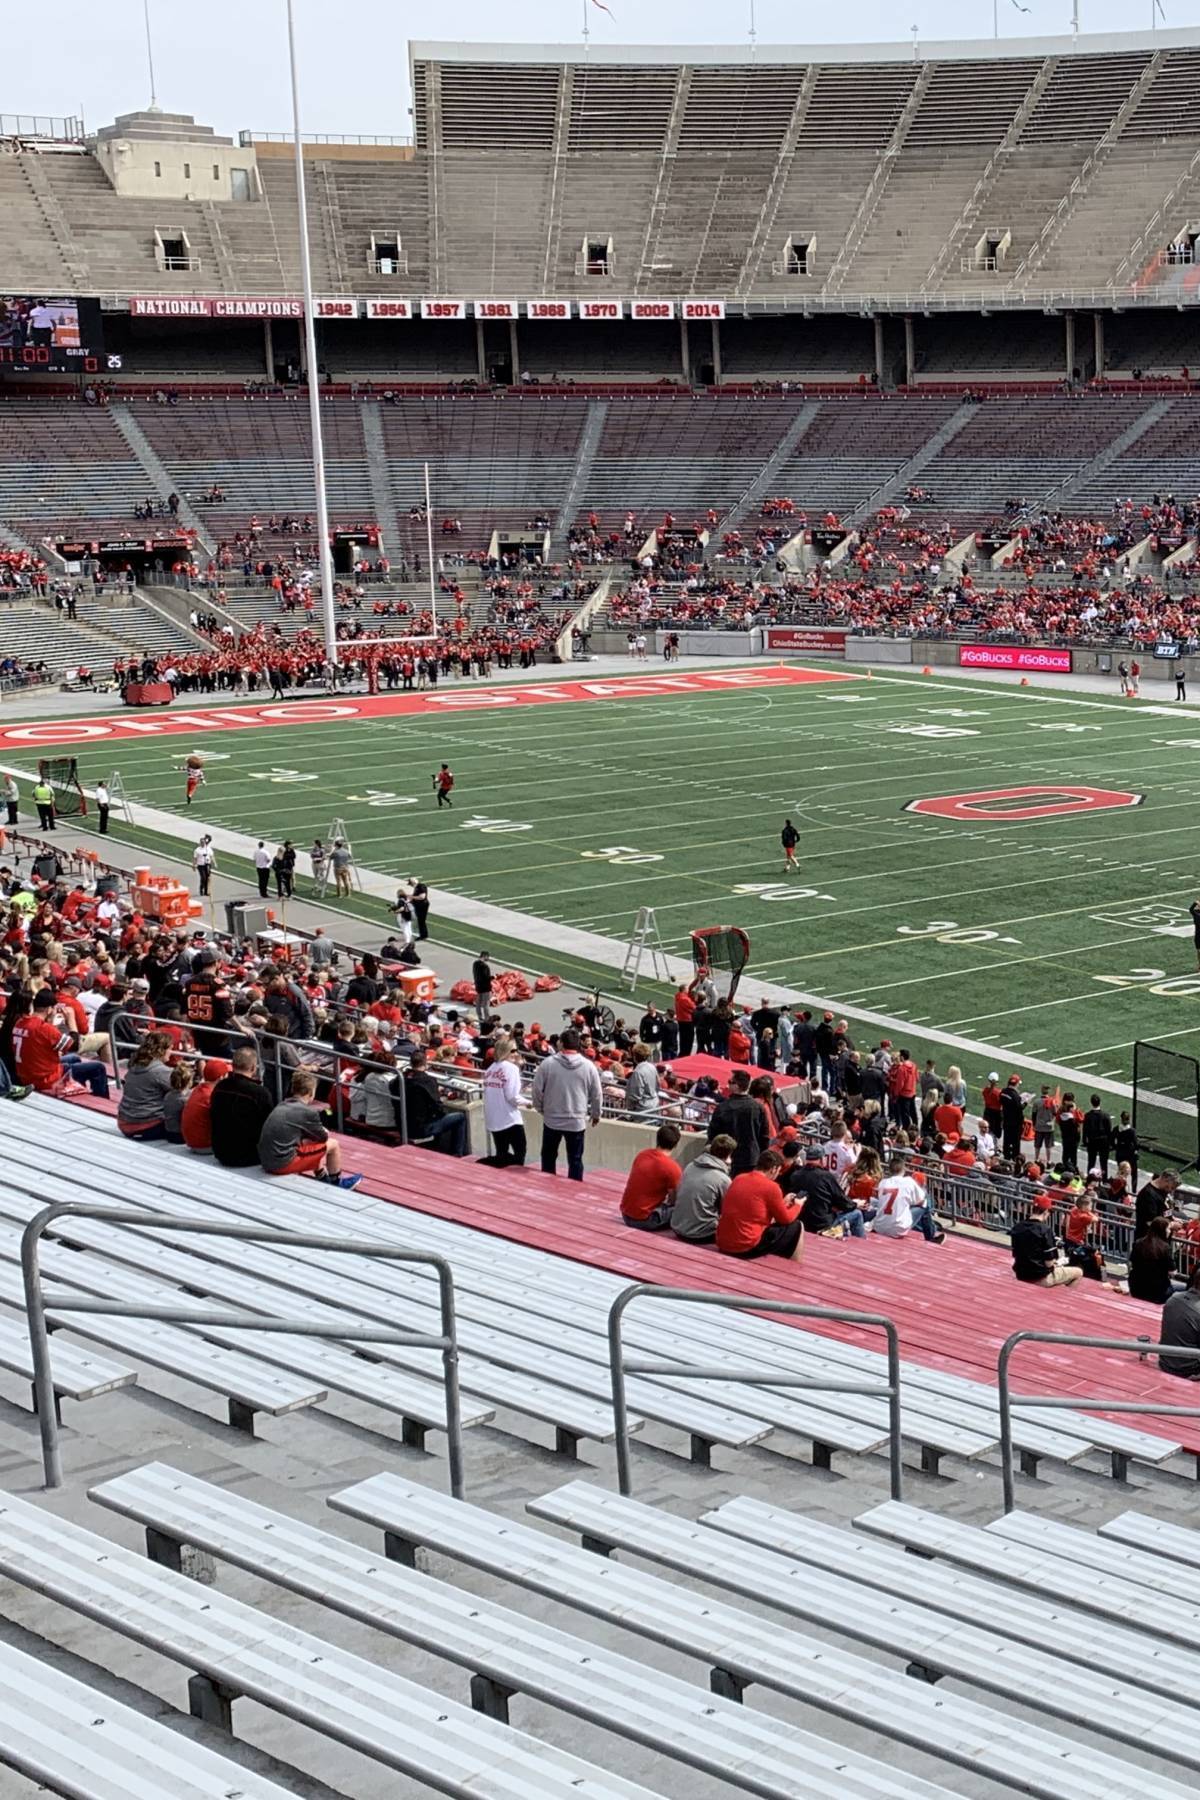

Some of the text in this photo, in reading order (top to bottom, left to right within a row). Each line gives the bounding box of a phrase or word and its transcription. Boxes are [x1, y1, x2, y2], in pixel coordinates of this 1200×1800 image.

[135, 300, 301, 316] NATIONAL CHAMPIONS
[316, 303, 354, 317] 1942
[371, 303, 406, 317] 1954
[426, 303, 460, 317] 1957
[479, 303, 513, 317] 1961
[531, 303, 567, 317] 1968
[584, 303, 618, 317] 1970
[635, 303, 669, 317] 2002
[686, 303, 720, 317] 2014
[424, 672, 792, 706] STATE
[3, 705, 361, 740] OHIO
[580, 846, 665, 864] 50
[730, 883, 819, 900] 40
[897, 921, 999, 943] 30
[187, 994, 213, 1020] 95
[881, 1187, 899, 1215] 7
